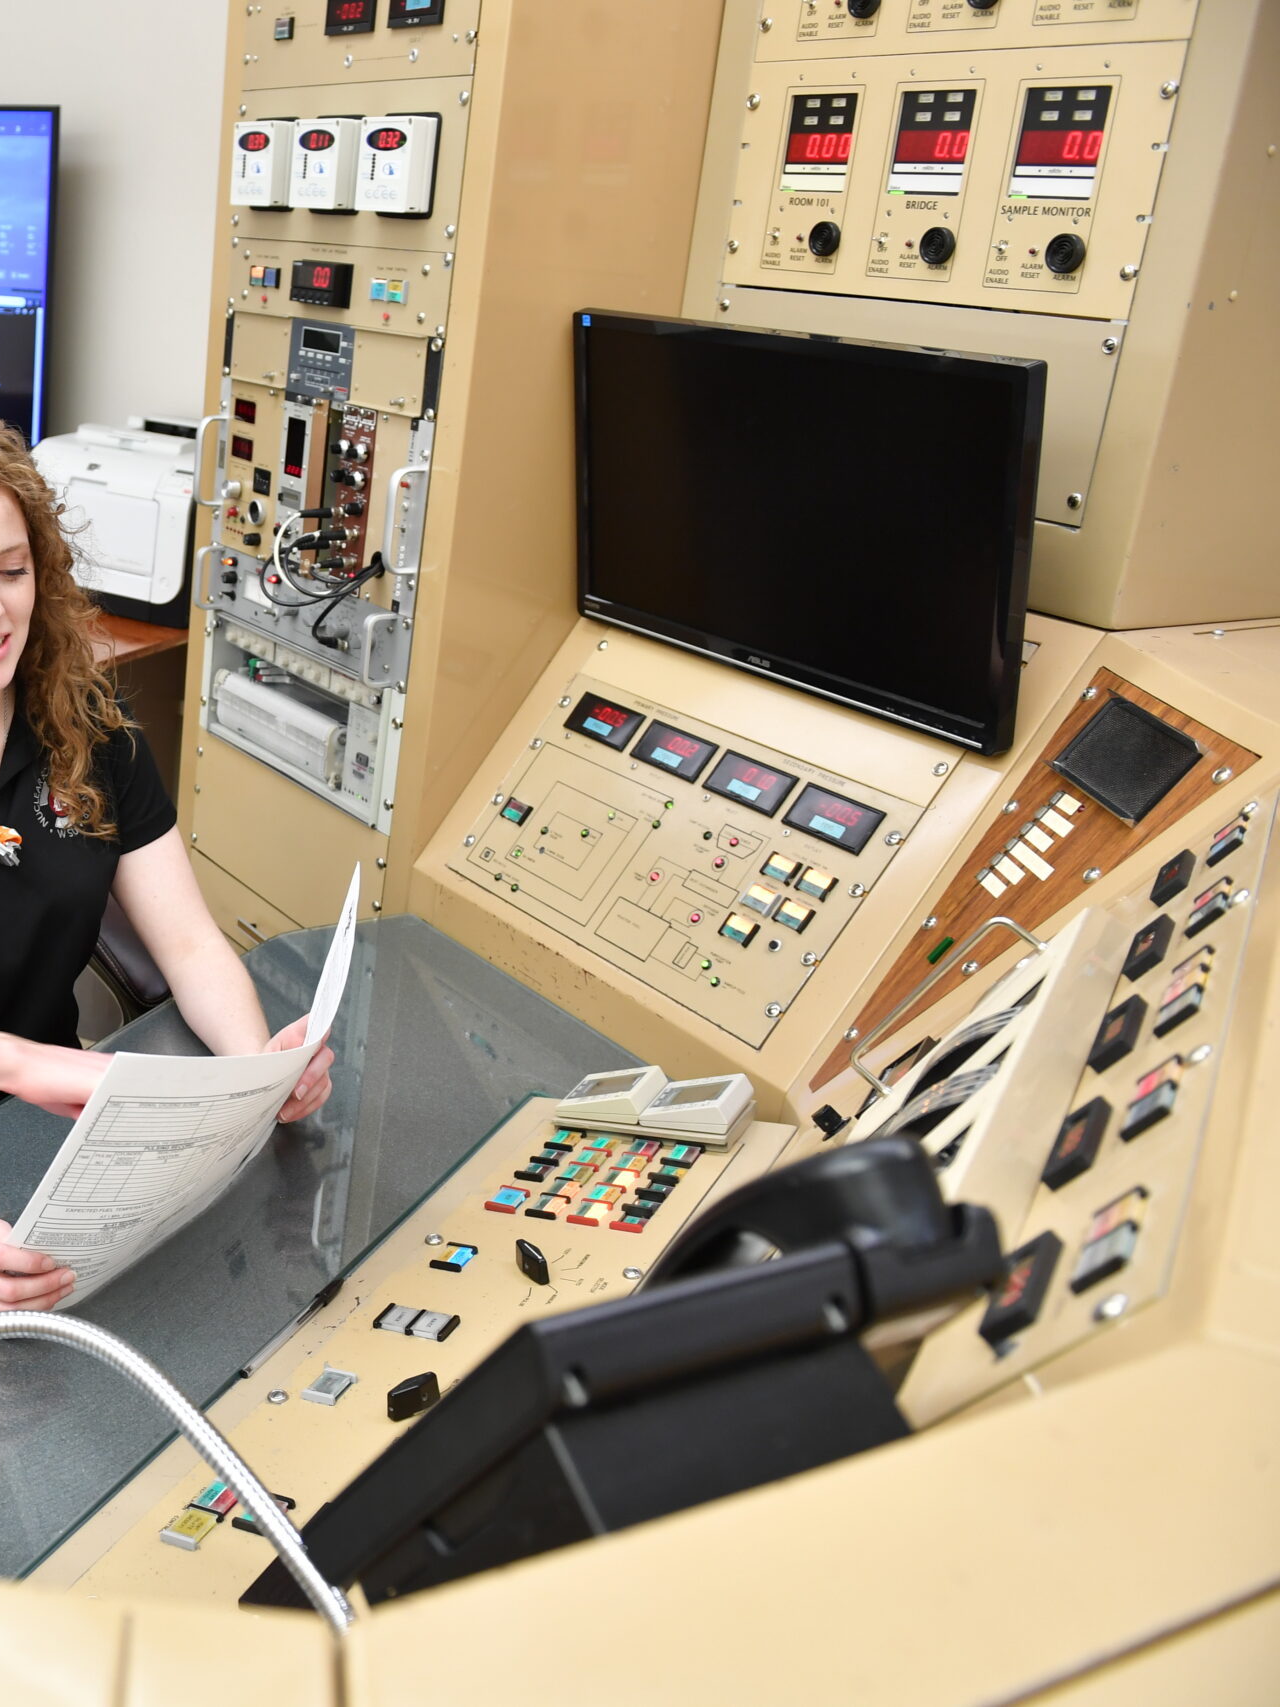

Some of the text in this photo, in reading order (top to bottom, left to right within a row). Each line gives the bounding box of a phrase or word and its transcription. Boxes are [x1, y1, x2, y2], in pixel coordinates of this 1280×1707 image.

[1035, 13, 1061, 21] ENABLE
[909, 21, 931, 29] ENABLE
[805, 133, 853, 158] 0.00
[934, 131, 970, 158] 0.0
[1061, 130, 1104, 160] 0.0
[789, 197, 830, 207] ROOM 101
[905, 200, 939, 211] BRIDGE
[1000, 204, 1092, 217] SAMPLE MONITOR
[814, 256, 833, 264] ALARM
[868, 266, 889, 274] ENABLE
[928, 263, 948, 271] ALARM
[985, 276, 1009, 285] ENABLE
[748, 655, 771, 668] ASUS
[783, 757, 847, 788] SECONDARY PRESSURE
[32, 776, 50, 828] NUCLEAR
[56, 826, 80, 839] WSU
